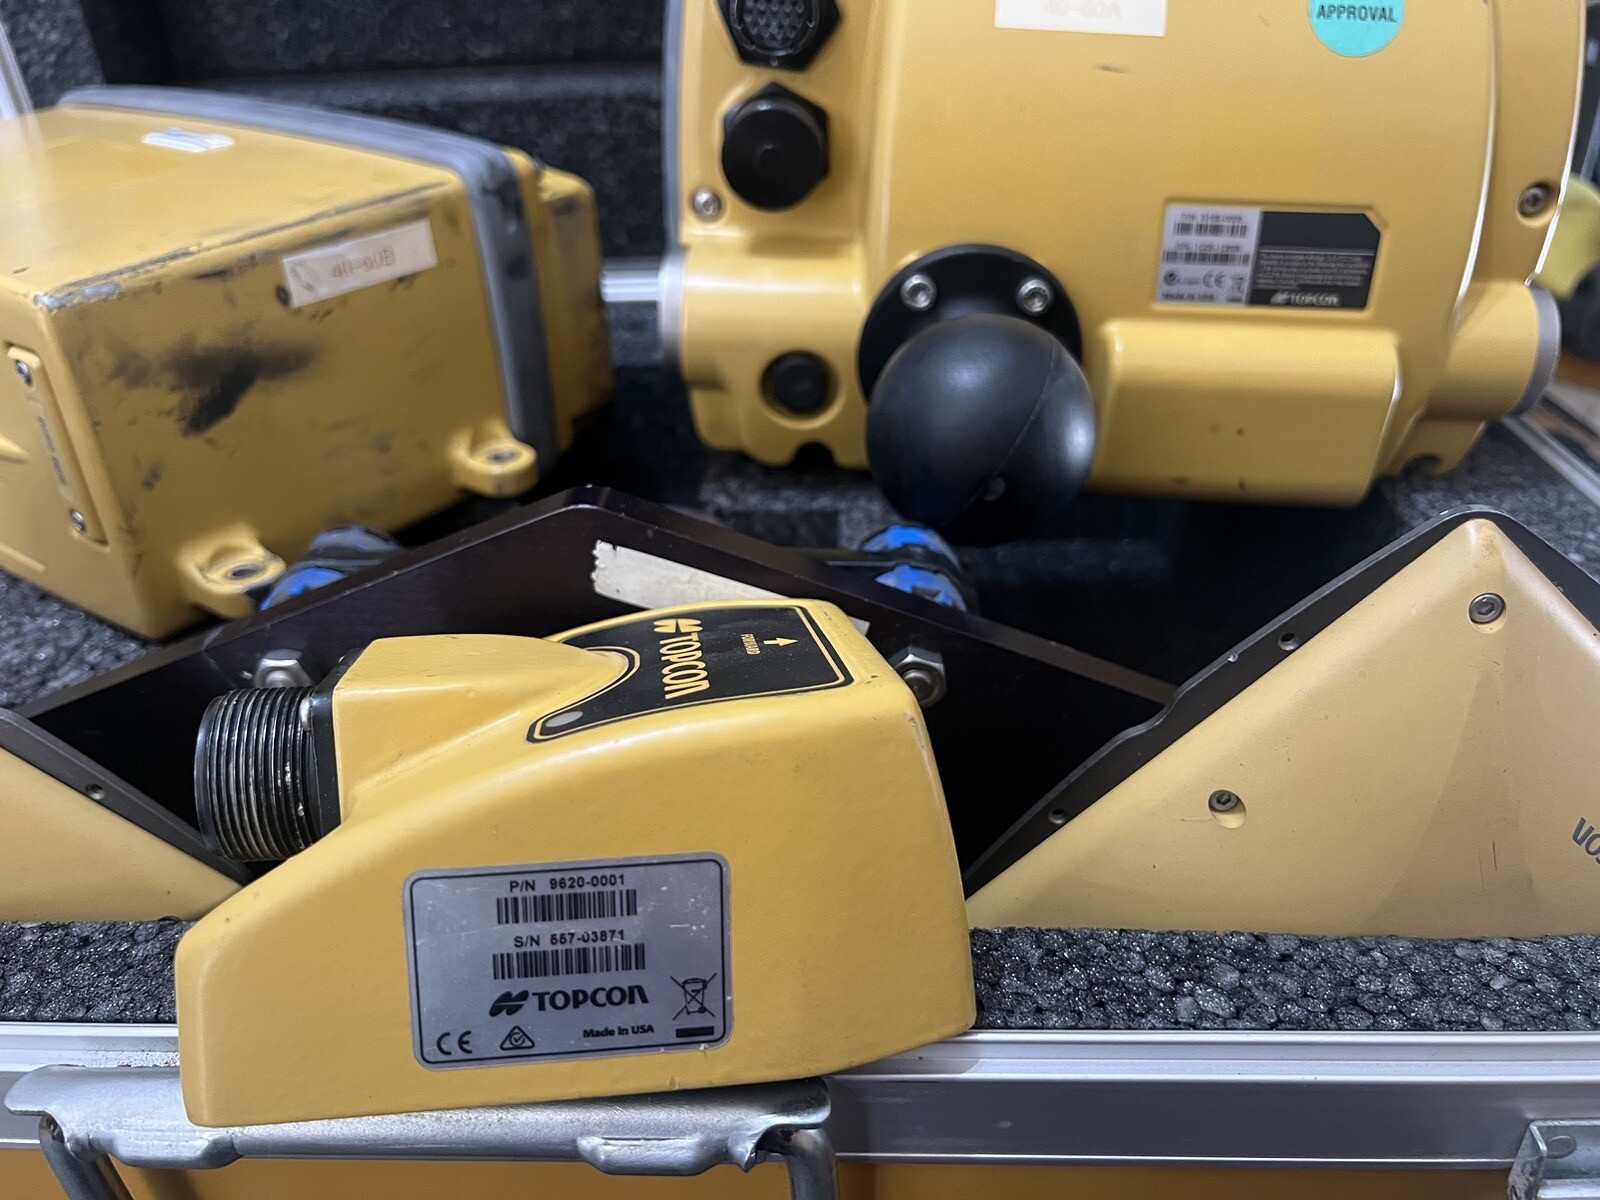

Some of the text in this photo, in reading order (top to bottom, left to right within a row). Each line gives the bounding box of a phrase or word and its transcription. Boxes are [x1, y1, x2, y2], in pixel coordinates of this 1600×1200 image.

[1317, 4, 1397, 23] APPROVAL
[659, 632, 711, 700] TOPCON
[509, 873, 625, 893] P/N 9620-0001
[514, 929, 625, 948] S/N 557-03871
[532, 984, 649, 1012] TOPCON
[583, 1023, 655, 1039] Made in USA
